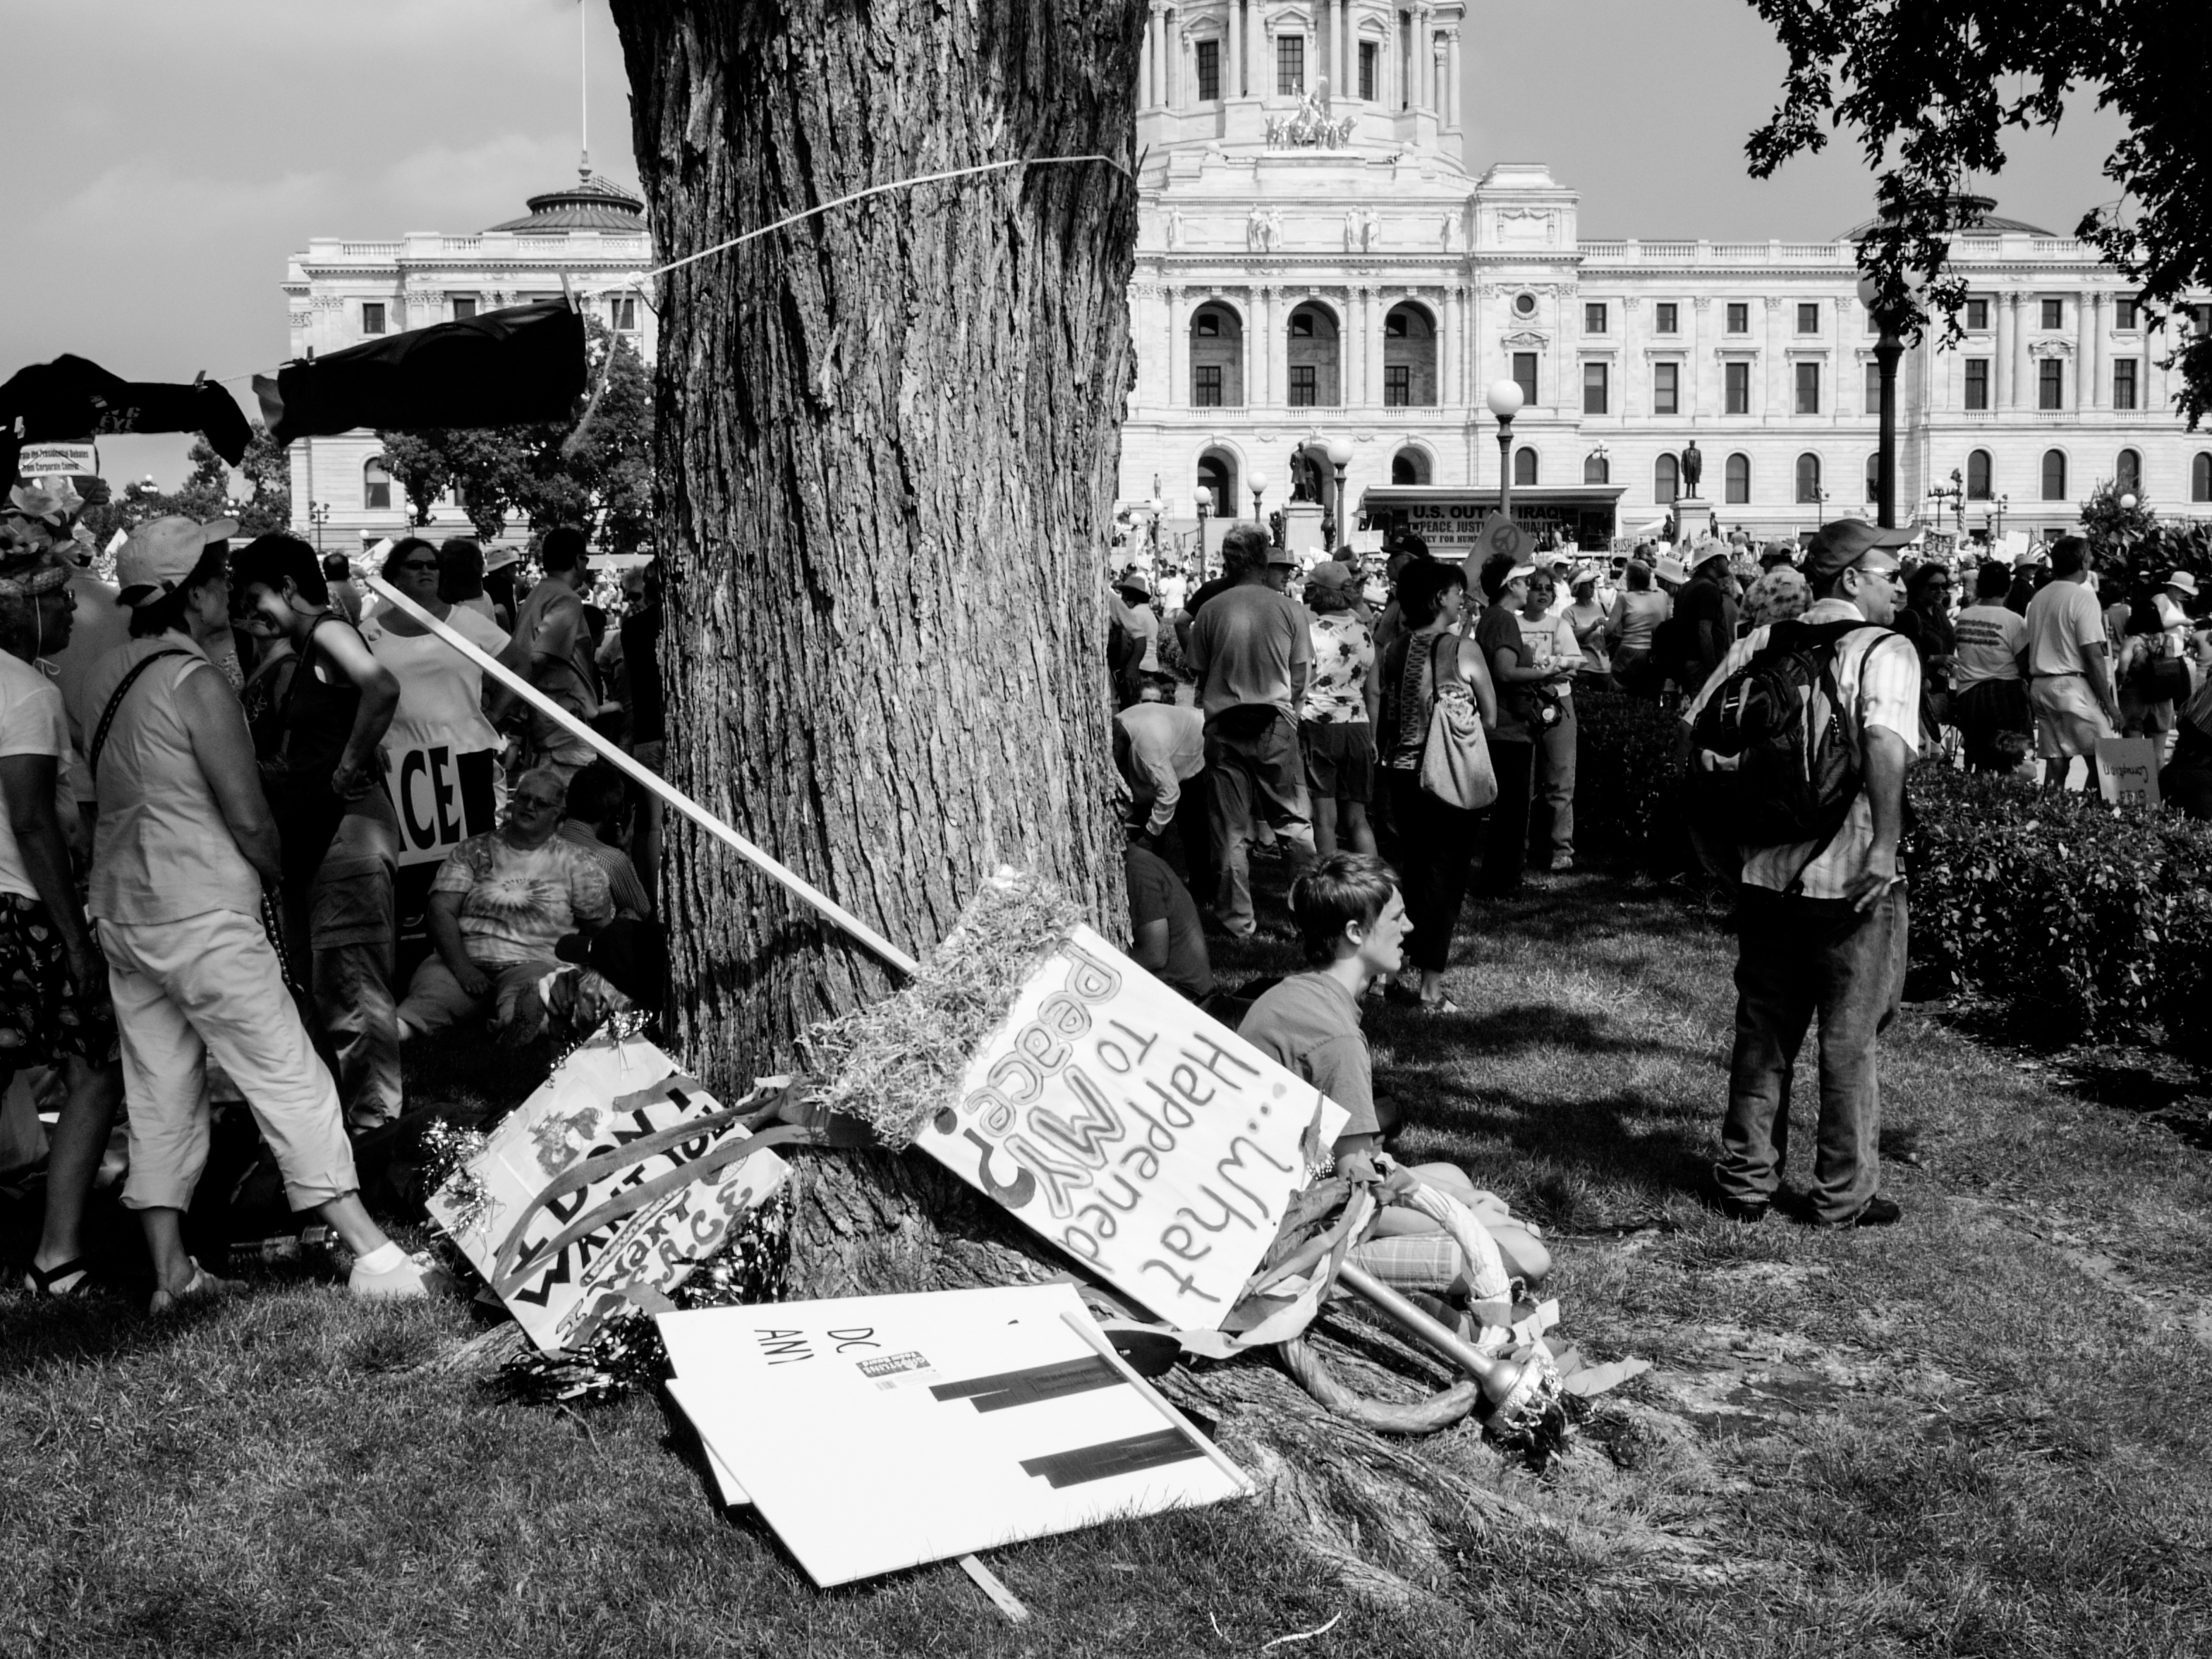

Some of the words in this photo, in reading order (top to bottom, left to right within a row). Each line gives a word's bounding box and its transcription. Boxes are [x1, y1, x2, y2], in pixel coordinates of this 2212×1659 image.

[1413, 506, 1445, 518] U.S.
[1450, 506, 1486, 518] OUT
[1421, 521, 1454, 533] PEACE,
[1457, 521, 1484, 533] JUSTI
[1613, 538, 1632, 553] BUSH
[1004, 1065, 1126, 1219] MY
[1058, 1031, 1260, 1274] Happened
[625, 1178, 753, 1293] EACE
